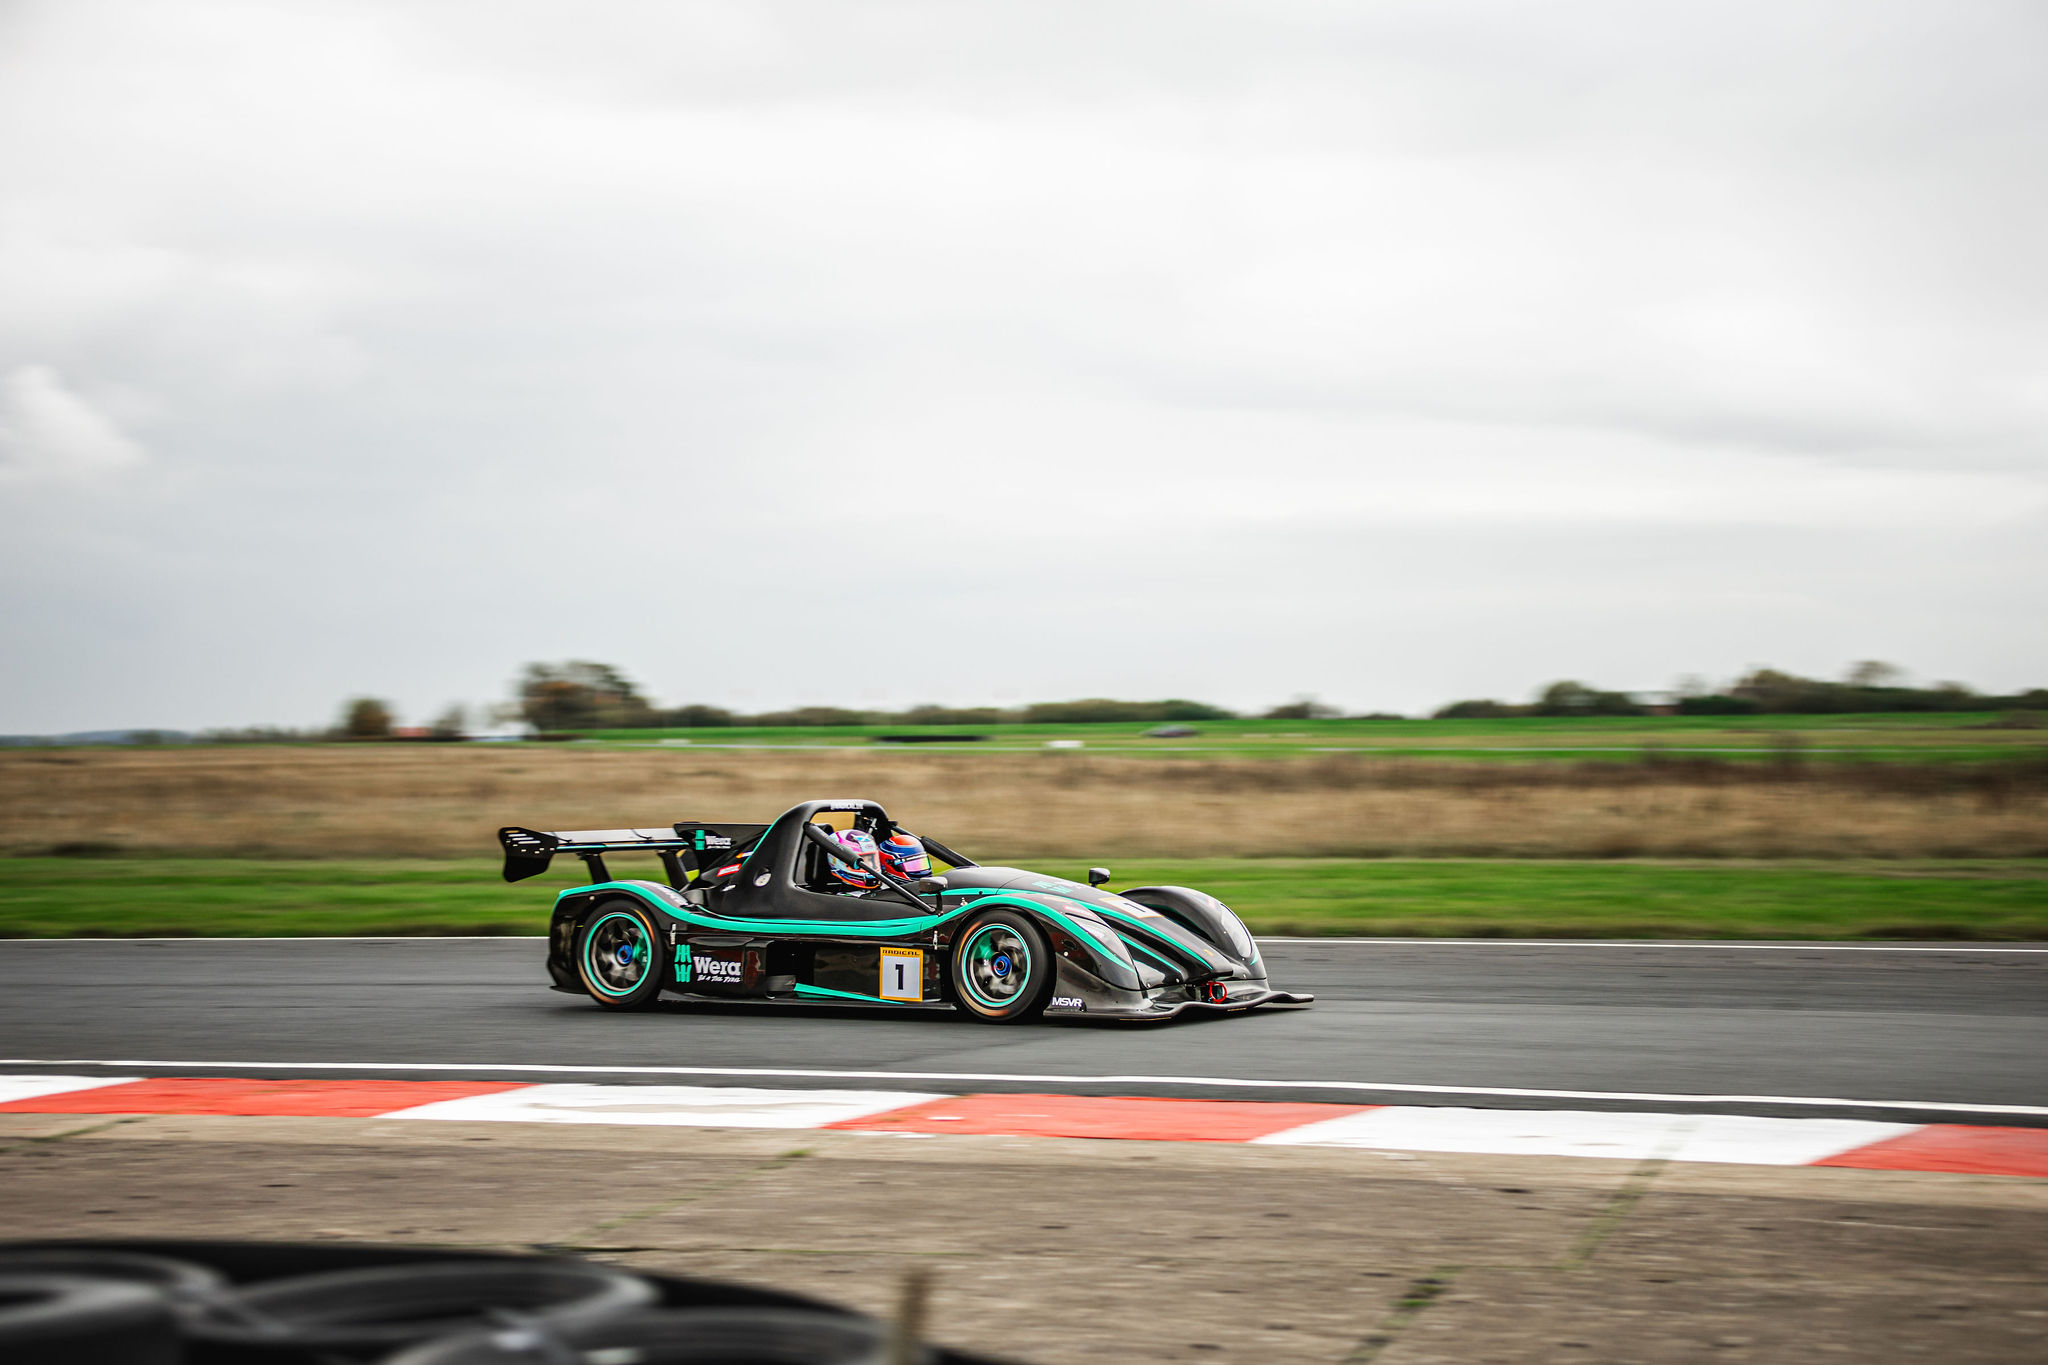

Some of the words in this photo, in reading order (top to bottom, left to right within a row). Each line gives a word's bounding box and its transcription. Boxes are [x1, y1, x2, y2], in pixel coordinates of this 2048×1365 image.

[693, 956, 741, 976] Wera
[895, 963, 904, 990] 1
[1052, 996, 1082, 1007] MSVR
